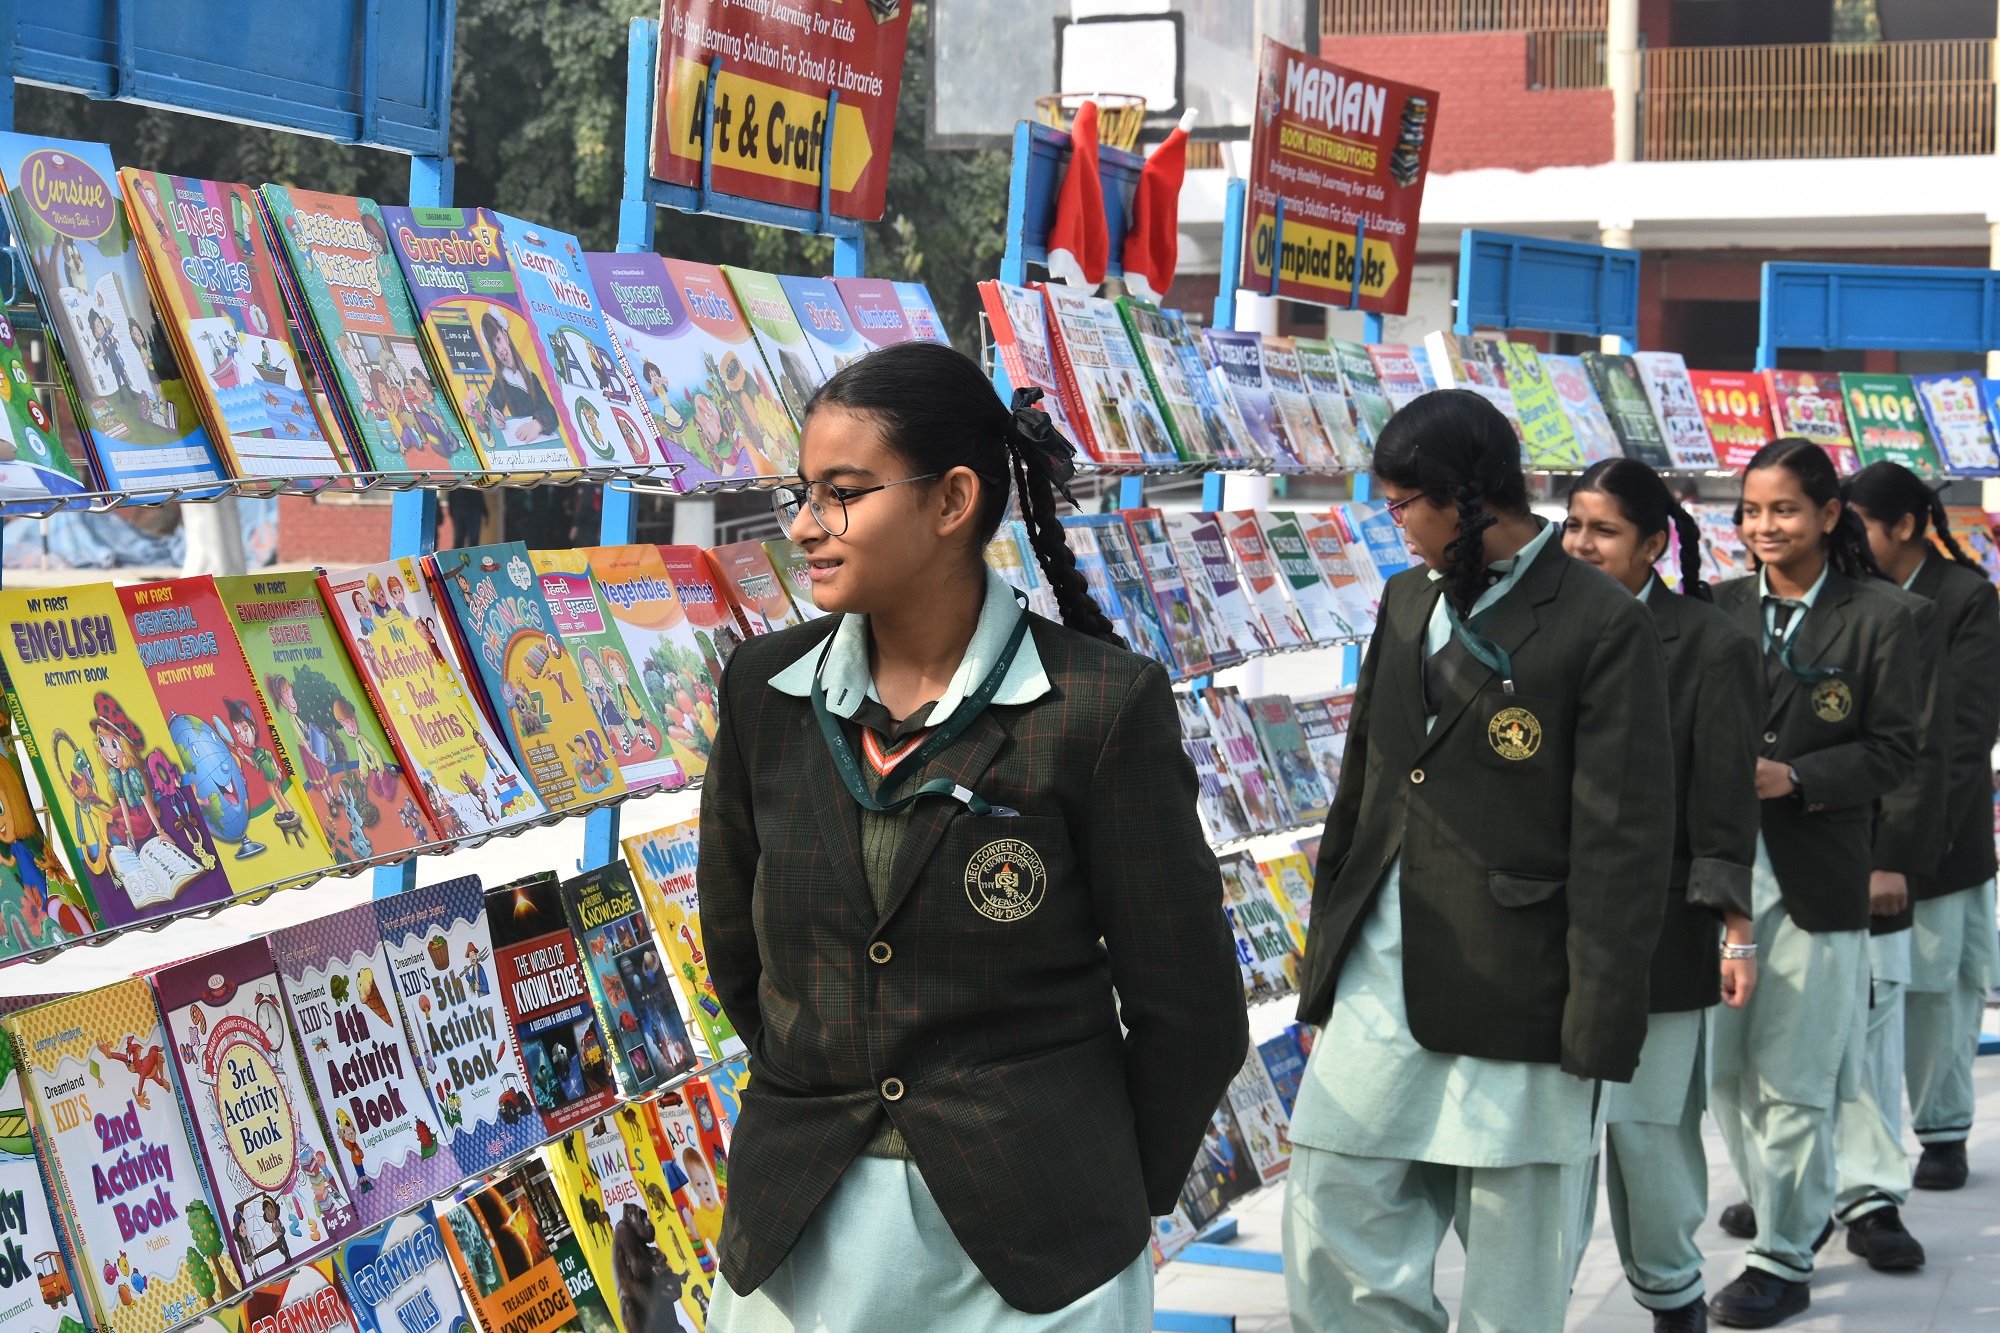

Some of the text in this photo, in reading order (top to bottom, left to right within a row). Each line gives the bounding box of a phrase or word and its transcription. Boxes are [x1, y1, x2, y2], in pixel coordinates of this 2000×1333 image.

[771, 2, 856, 43] Learning For Kids
[670, 6, 883, 97] One Stop Learning Solution For School & Libraries
[1284, 57, 1386, 137] MARIAN
[738, 94, 759, 159] &
[1280, 126, 1378, 170] BOOK DISTRIBUTORS
[32, 158, 106, 209] Cursive
[1269, 159, 1385, 201] Bringing Healthy Learning For Kids
[52, 211, 76, 227] Writing
[169, 201, 226, 239] LINES
[298, 212, 373, 251] Pattern
[426, 213, 452, 222] DREAMLAND
[1304, 197, 1330, 220] Solution
[1330, 204, 1341, 221] For
[1371, 213, 1406, 236] Libraries
[198, 237, 220, 260] AND
[399, 227, 490, 267] Cursive
[514, 240, 558, 276] Learn
[182, 259, 251, 293] CURVES
[312, 250, 382, 296] Writing
[411, 264, 469, 294] Writing
[548, 274, 592, 312] Write
[610, 281, 664, 307] Nursery
[684, 287, 735, 322] Fruits
[750, 291, 792, 323] Animals
[531, 300, 598, 330] CAPITAL LETTERS
[621, 303, 673, 331] Rhymes
[804, 301, 845, 331] Birds
[854, 304, 903, 329] Numbers
[1213, 340, 1260, 366] SCIENCE
[1054, 334, 1085, 415] ULTIMATE KNOWLEDGE
[1701, 388, 1762, 418] 1101
[1855, 393, 1917, 423] 1101
[134, 587, 174, 606] MY FIRST
[254, 580, 288, 596] MY FIRST
[543, 578, 571, 596] हिन्दी
[598, 573, 672, 610] Vegetables
[27, 596, 69, 614] MY FIRST
[134, 604, 198, 638] GENERAL
[235, 597, 325, 624] ENVIRONMENTAL
[468, 576, 499, 635] LEARN
[563, 596, 597, 620] पुस्तक
[11, 614, 116, 663] ENGLISH
[136, 631, 219, 669] KNOWLEDGE
[267, 621, 312, 646] SCIENCE
[388, 624, 408, 646] My
[482, 597, 544, 675] PHONICS
[273, 645, 324, 664] ACTIVITY BOOK
[380, 643, 436, 686] Activity
[44, 666, 110, 687] ACTIVITY BOOK
[157, 662, 216, 686] ACTIVITY BOOK
[406, 677, 438, 711] Book
[6, 692, 39, 758] ACTIVITY BOOK
[410, 709, 466, 750] Maths
[967, 841, 1044, 883] NEO CONVENT SCHOOL
[983, 854, 1029, 875] KNOWLEDGE
[659, 873, 696, 897] WRITING
[981, 881, 995, 890] THY
[989, 892, 1026, 908] WEALTH
[577, 892, 636, 931] KNOWLEDGE
[980, 900, 1035, 920] NEW DELHI
[1236, 898, 1275, 928] KNOW
[394, 951, 425, 971] Dreamland
[513, 943, 565, 978] THE WORLD OF
[1254, 930, 1292, 962] WHEN
[210, 976, 223, 987] ALKA
[292, 985, 326, 1006] Dreamland
[400, 966, 431, 999] KID'S
[432, 968, 467, 1013] 5th
[511, 963, 584, 1015] KNOWLEDGE
[297, 1002, 332, 1036] KID'S
[334, 1003, 371, 1048] 4th
[426, 1003, 497, 1059] Activity
[593, 1001, 621, 1065] KNOWLEDGE
[17, 1034, 33, 1075] DREAMLAND
[207, 1020, 248, 1059] SMART LEARNING FOR
[227, 1057, 258, 1090] 3rd
[327, 1038, 405, 1099] Activity
[447, 1042, 499, 1093] Book
[44, 1073, 86, 1099] Dreamland
[470, 1085, 491, 1101] Science
[224, 1082, 281, 1129] Activity
[349, 1080, 408, 1136] Book
[95, 1100, 143, 1153] 2nd
[240, 1117, 283, 1155] Book
[362, 1119, 413, 1150] Logical Reasoning
[586, 1133, 622, 1150] PRESCHOOL LEARNER
[92, 1142, 175, 1205] Activity
[257, 1153, 284, 1175] Maths
[581, 1147, 645, 1195] ANIMALS
[604, 1179, 639, 1207] BABIES
[113, 1183, 179, 1244] Book
[326, 1212, 351, 1230] Age 5+
[58, 1213, 77, 1260] ENVIRONMENT
[76, 1223, 88, 1247] MATHS
[146, 1234, 171, 1255] Maths
[353, 1223, 445, 1308] GRAMMAR
[460, 1271, 478, 1307] TREASURY
[501, 1284, 533, 1316] TREASURY
[534, 1274, 550, 1295] OF
[163, 1297, 185, 1323] Age
[251, 1284, 348, 1333] GRAMMAR
[396, 1287, 441, 1333] SKILLS
[500, 1289, 569, 1333] KNOWLEDGE
